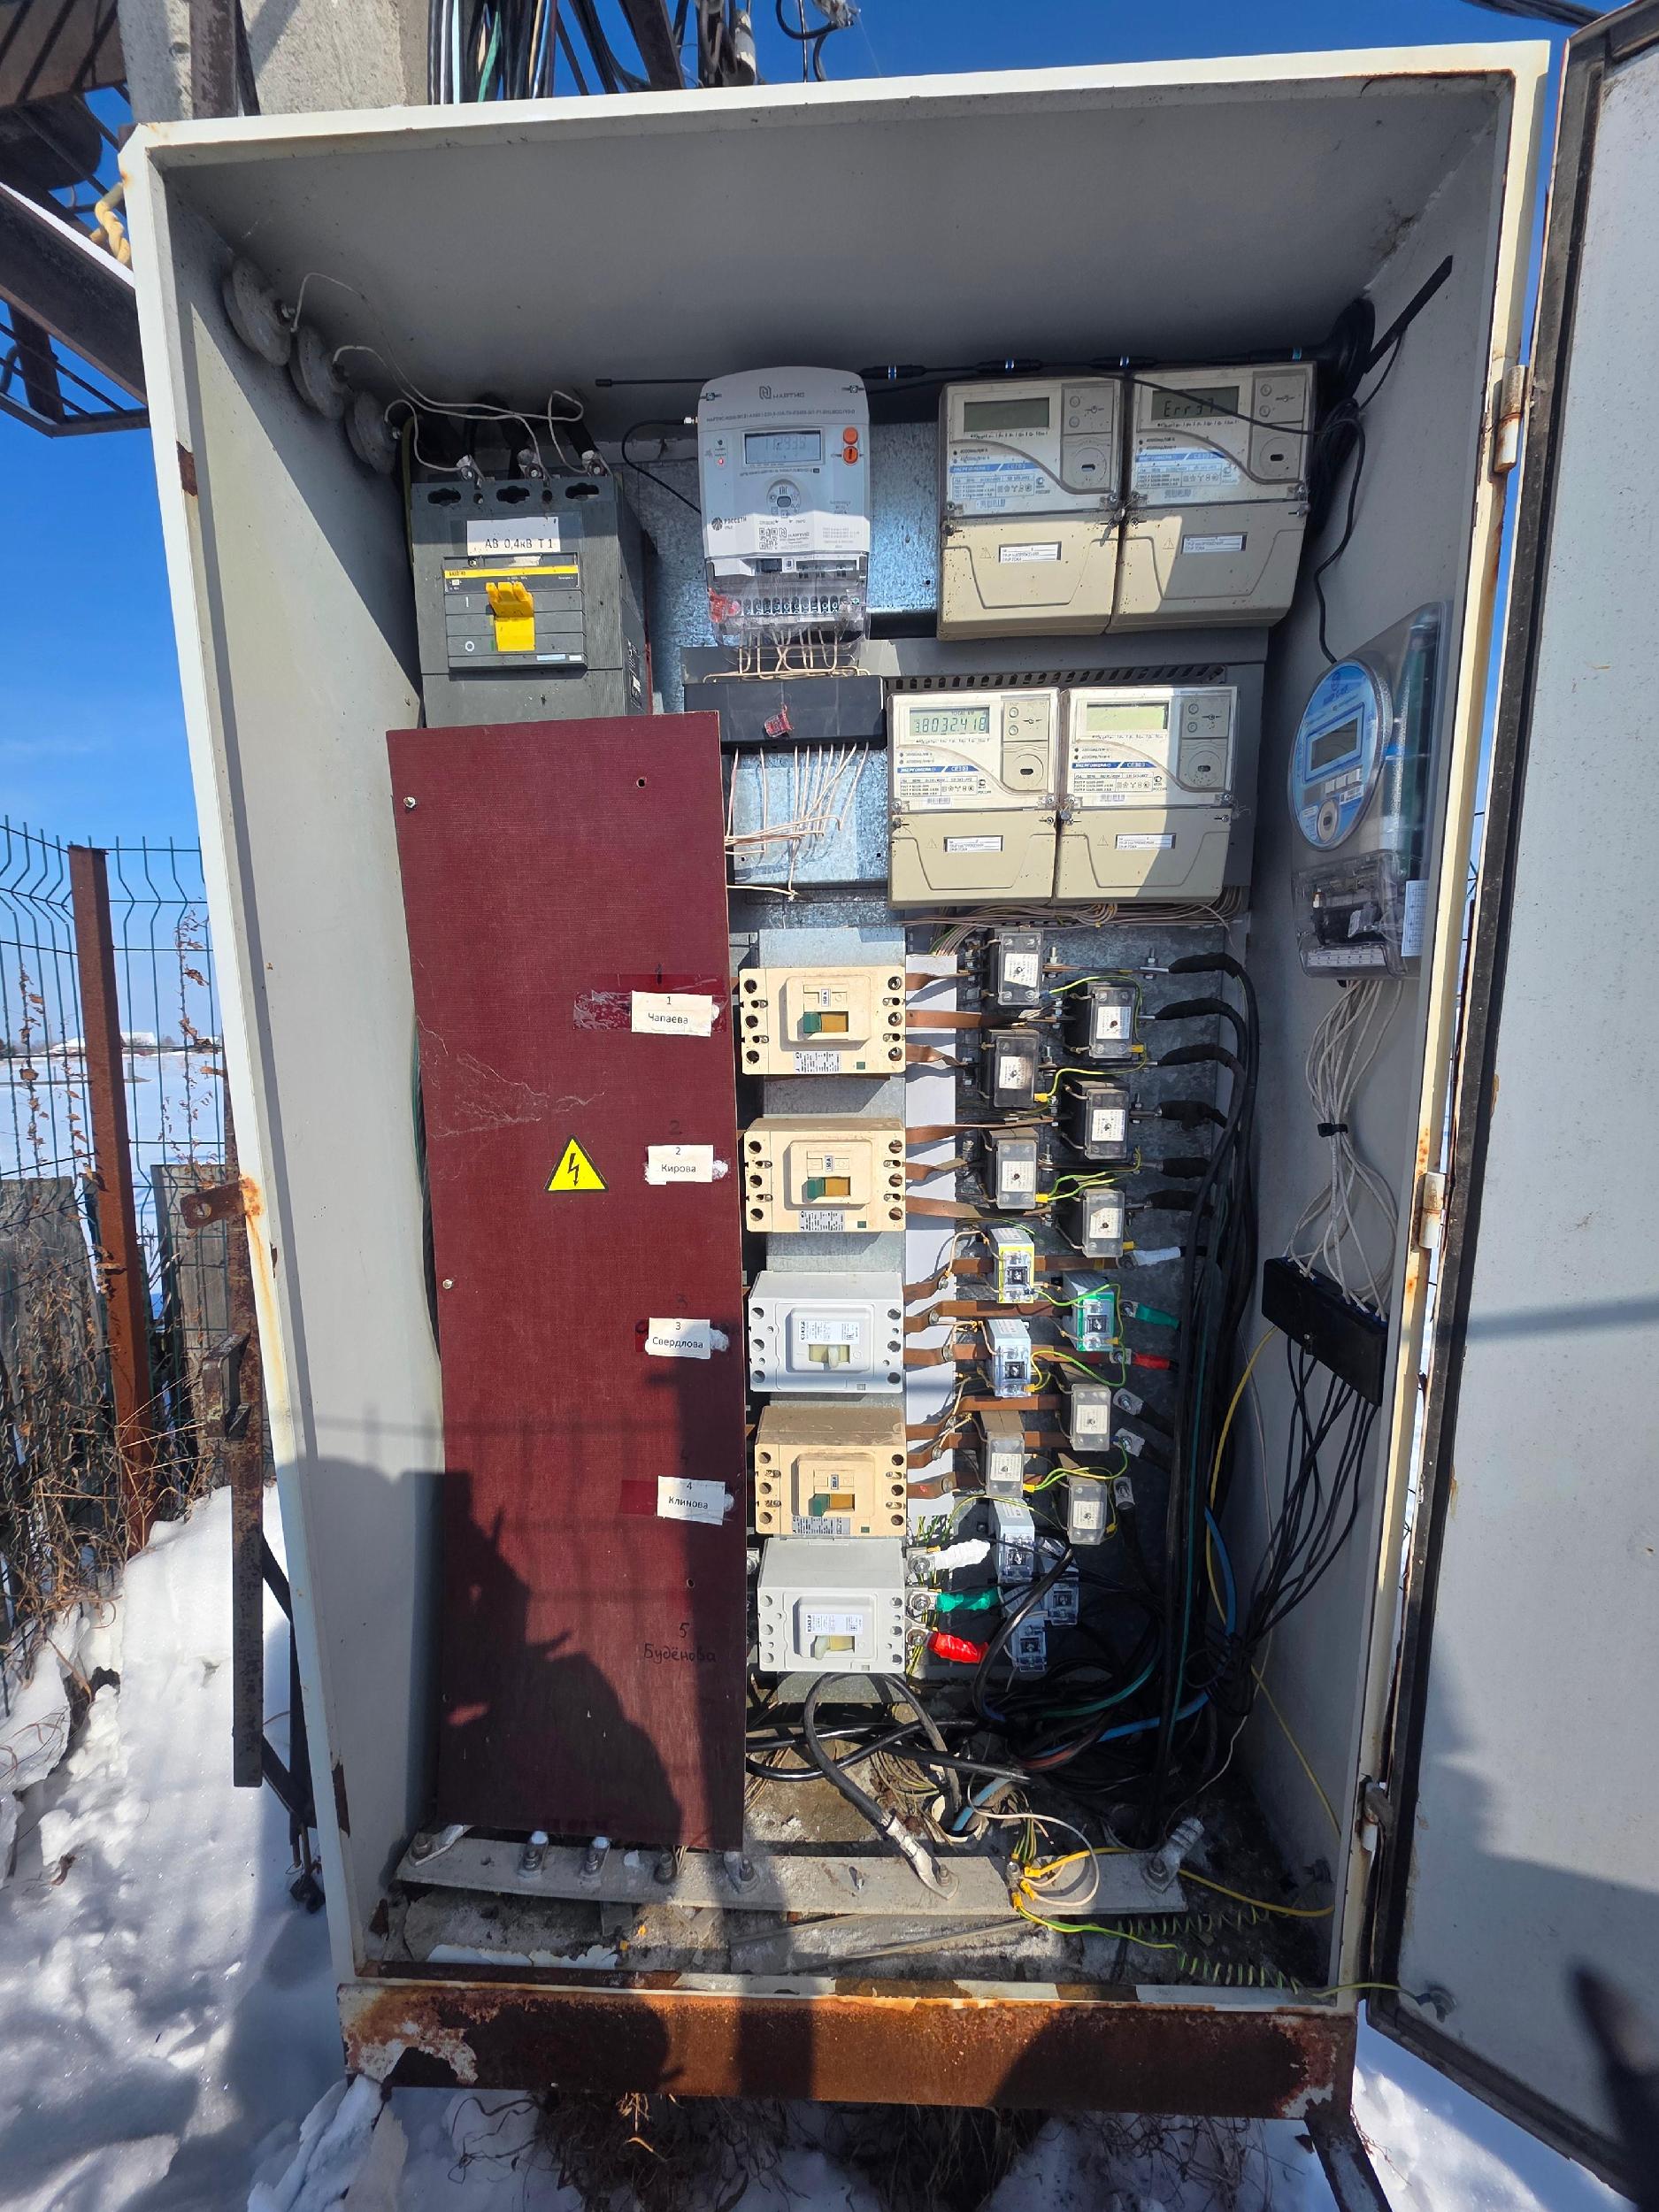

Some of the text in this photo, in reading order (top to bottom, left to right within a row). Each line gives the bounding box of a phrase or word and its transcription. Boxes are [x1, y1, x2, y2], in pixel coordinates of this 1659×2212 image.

[485, 538, 553, 550] АВ 0,4кВ Т 1
[666, 996, 672, 1005] 1
[648, 1012, 688, 1025] Чапаева
[675, 1147, 681, 1156] 2
[661, 1164, 696, 1173] Кирова
[675, 1322, 681, 1331] 3
[652, 1336, 703, 1349] Свердлова
[686, 1481, 692, 1490] 4
[668, 1496, 709, 1509] Клинова
[679, 1622, 689, 1639] 5
[643, 1643, 717, 1664] Будёнова
